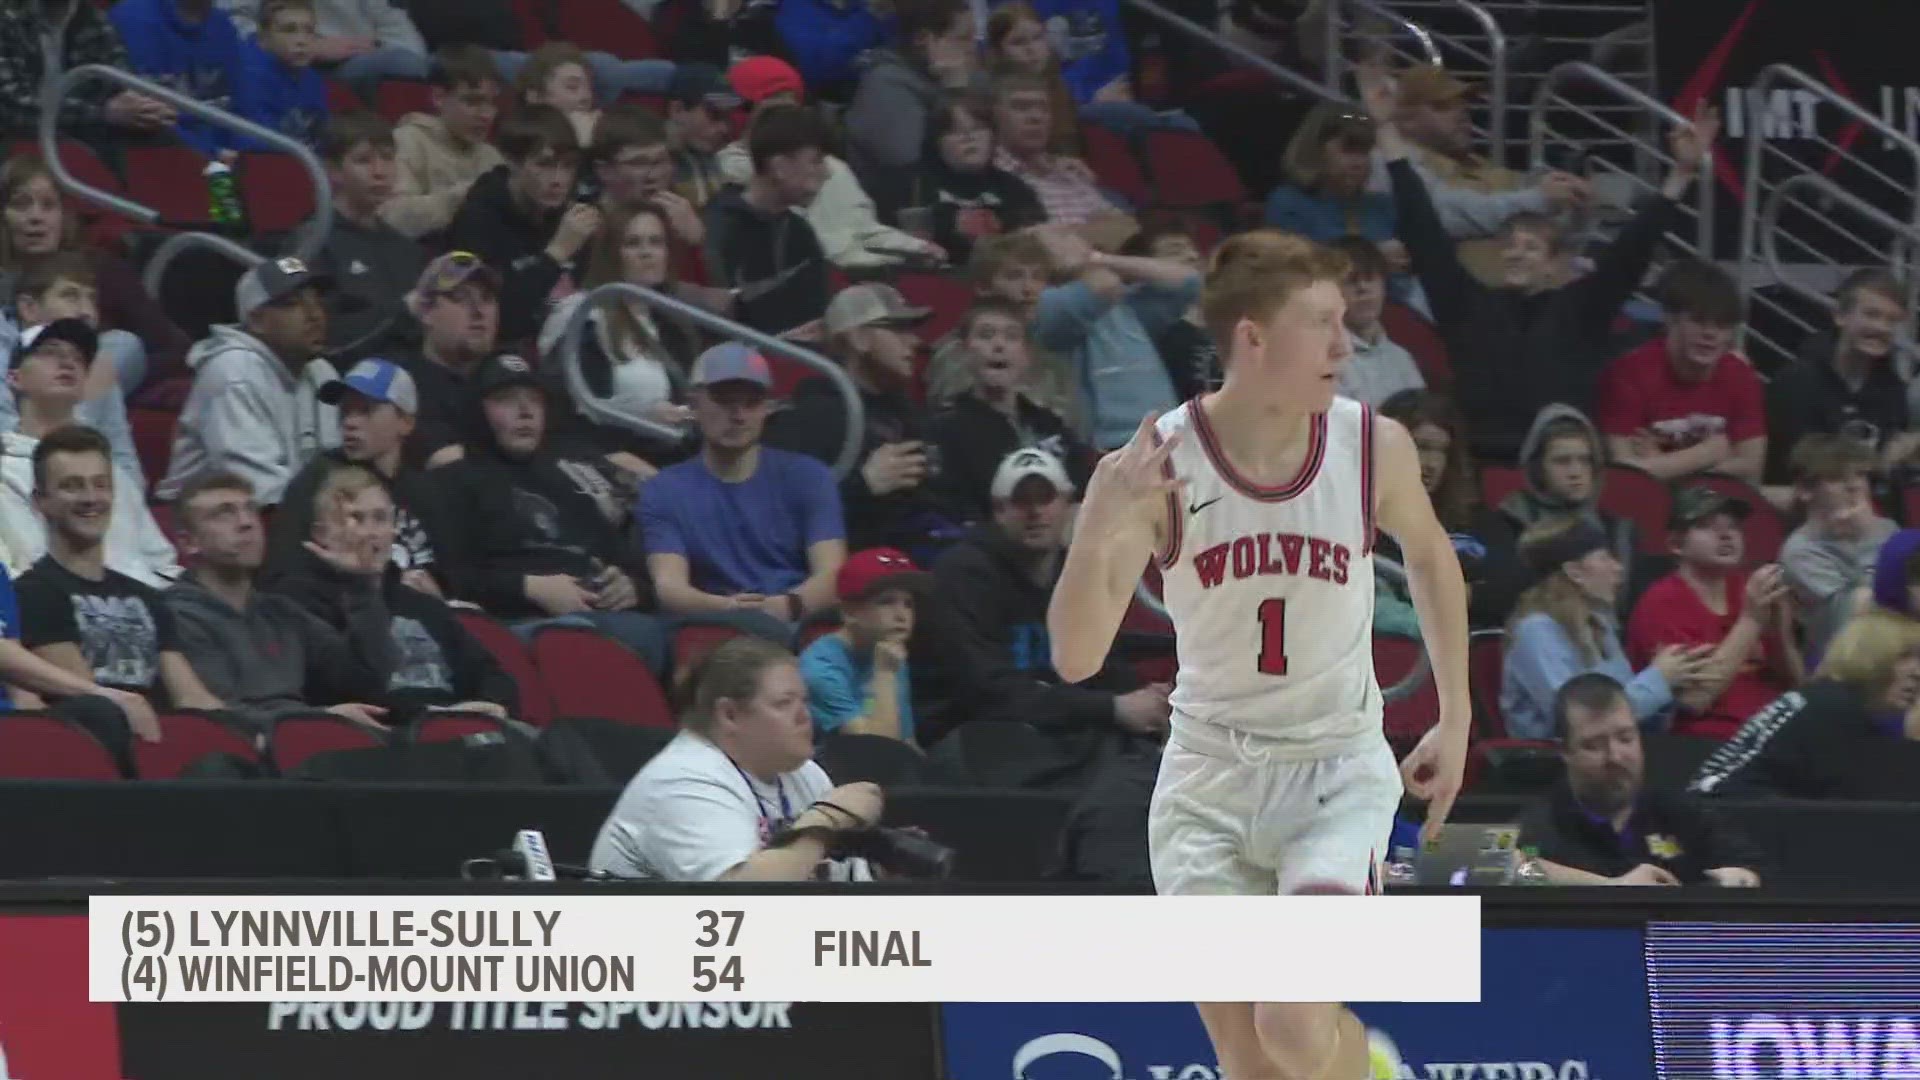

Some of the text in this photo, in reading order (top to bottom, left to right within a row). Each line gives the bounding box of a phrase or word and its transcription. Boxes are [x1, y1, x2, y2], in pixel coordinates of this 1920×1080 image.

[1194, 533, 1350, 589] WOLVES
[1258, 597, 1287, 676] 1
[267, 1001, 434, 1030] PROUD
[578, 1001, 792, 1029] SPONSOR
